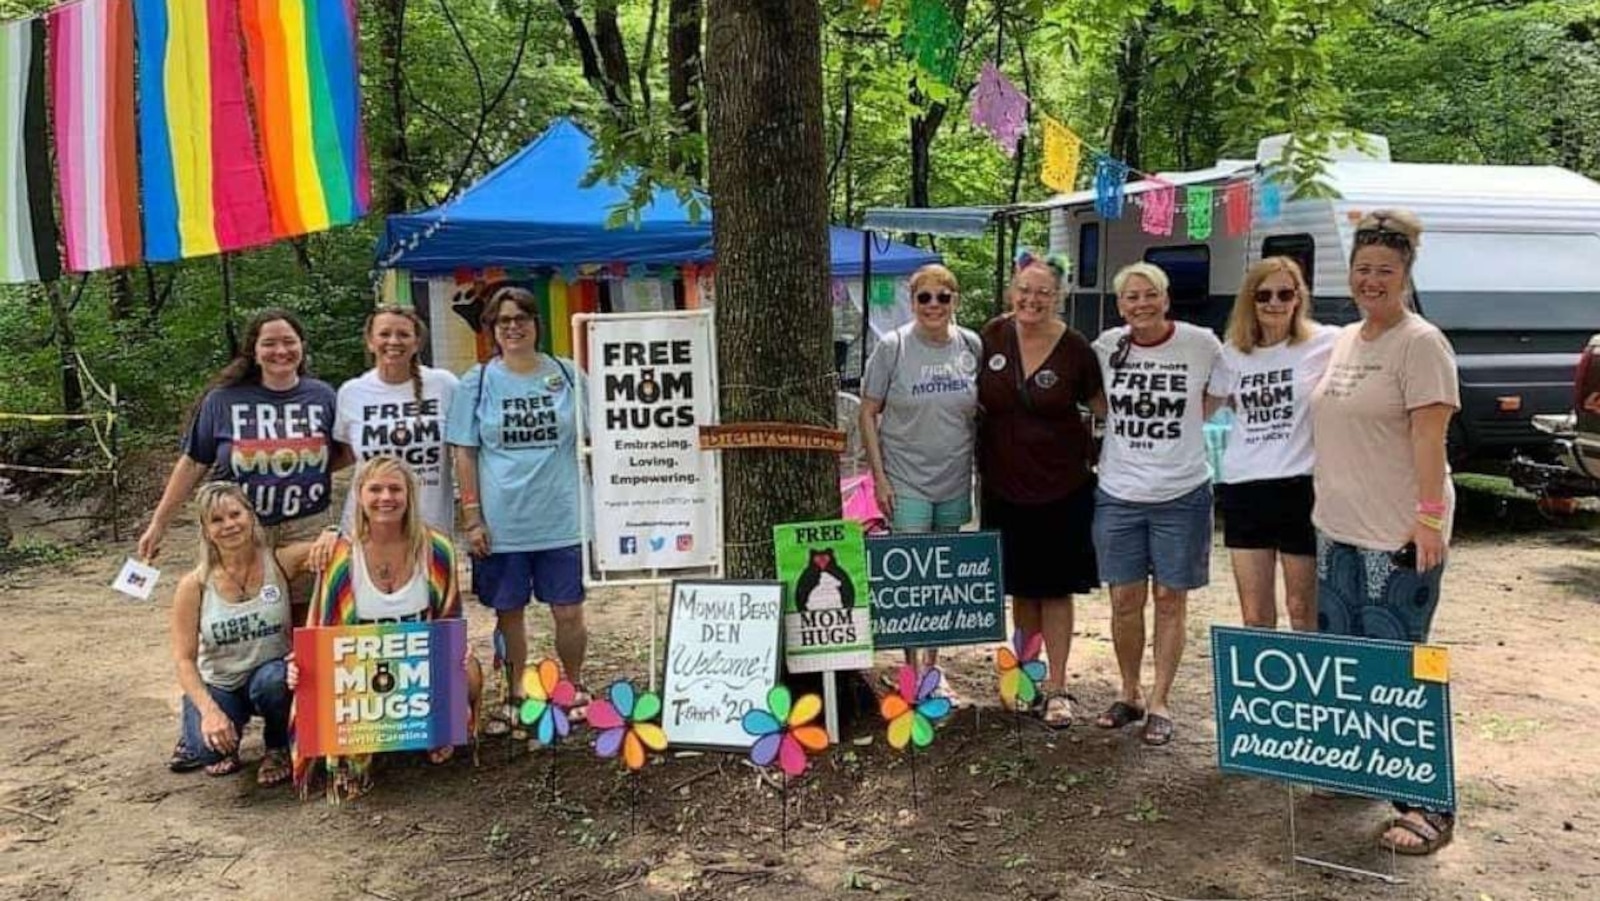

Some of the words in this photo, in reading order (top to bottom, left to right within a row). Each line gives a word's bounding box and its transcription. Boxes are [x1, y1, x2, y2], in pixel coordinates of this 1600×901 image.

[603, 340, 692, 367] FREE
[605, 370, 693, 404] MOM
[1111, 372, 1188, 392] FREE
[1241, 369, 1293, 389] FREE
[502, 395, 554, 411] FREE
[1110, 393, 1187, 419] MOM
[1241, 386, 1293, 409] MOM
[231, 403, 325, 440] FREE
[364, 399, 438, 421] FREE
[503, 410, 556, 428] MOM
[606, 405, 695, 430] HUGS
[1247, 406, 1293, 424] HUGS
[362, 420, 440, 448] MOM
[503, 426, 558, 443] HUGS
[1113, 419, 1182, 440] HUGS
[614, 437, 693, 450] Embracing.
[230, 445, 328, 478] MOM
[629, 456, 679, 469] Loving.
[610, 473, 700, 486] Empowering.
[241, 483, 325, 517] UGS
[795, 524, 845, 544] FREE
[866, 546, 953, 581] LOVE
[957, 556, 992, 577] and
[867, 581, 995, 609] ACCEPTANCE
[801, 607, 854, 628] MOM
[954, 607, 997, 630] here
[702, 623, 741, 644] DEN
[801, 626, 857, 647] HUGS
[333, 631, 430, 662] FREE
[673, 645, 773, 683] Welcome!
[335, 661, 430, 695] MOM
[1230, 645, 1362, 700] LOVE
[1370, 684, 1428, 709] and
[336, 692, 431, 723] HUGS
[1229, 694, 1436, 750] ACCEPTANCE
[1230, 732, 1363, 771] practiced
[1366, 748, 1437, 783] here
